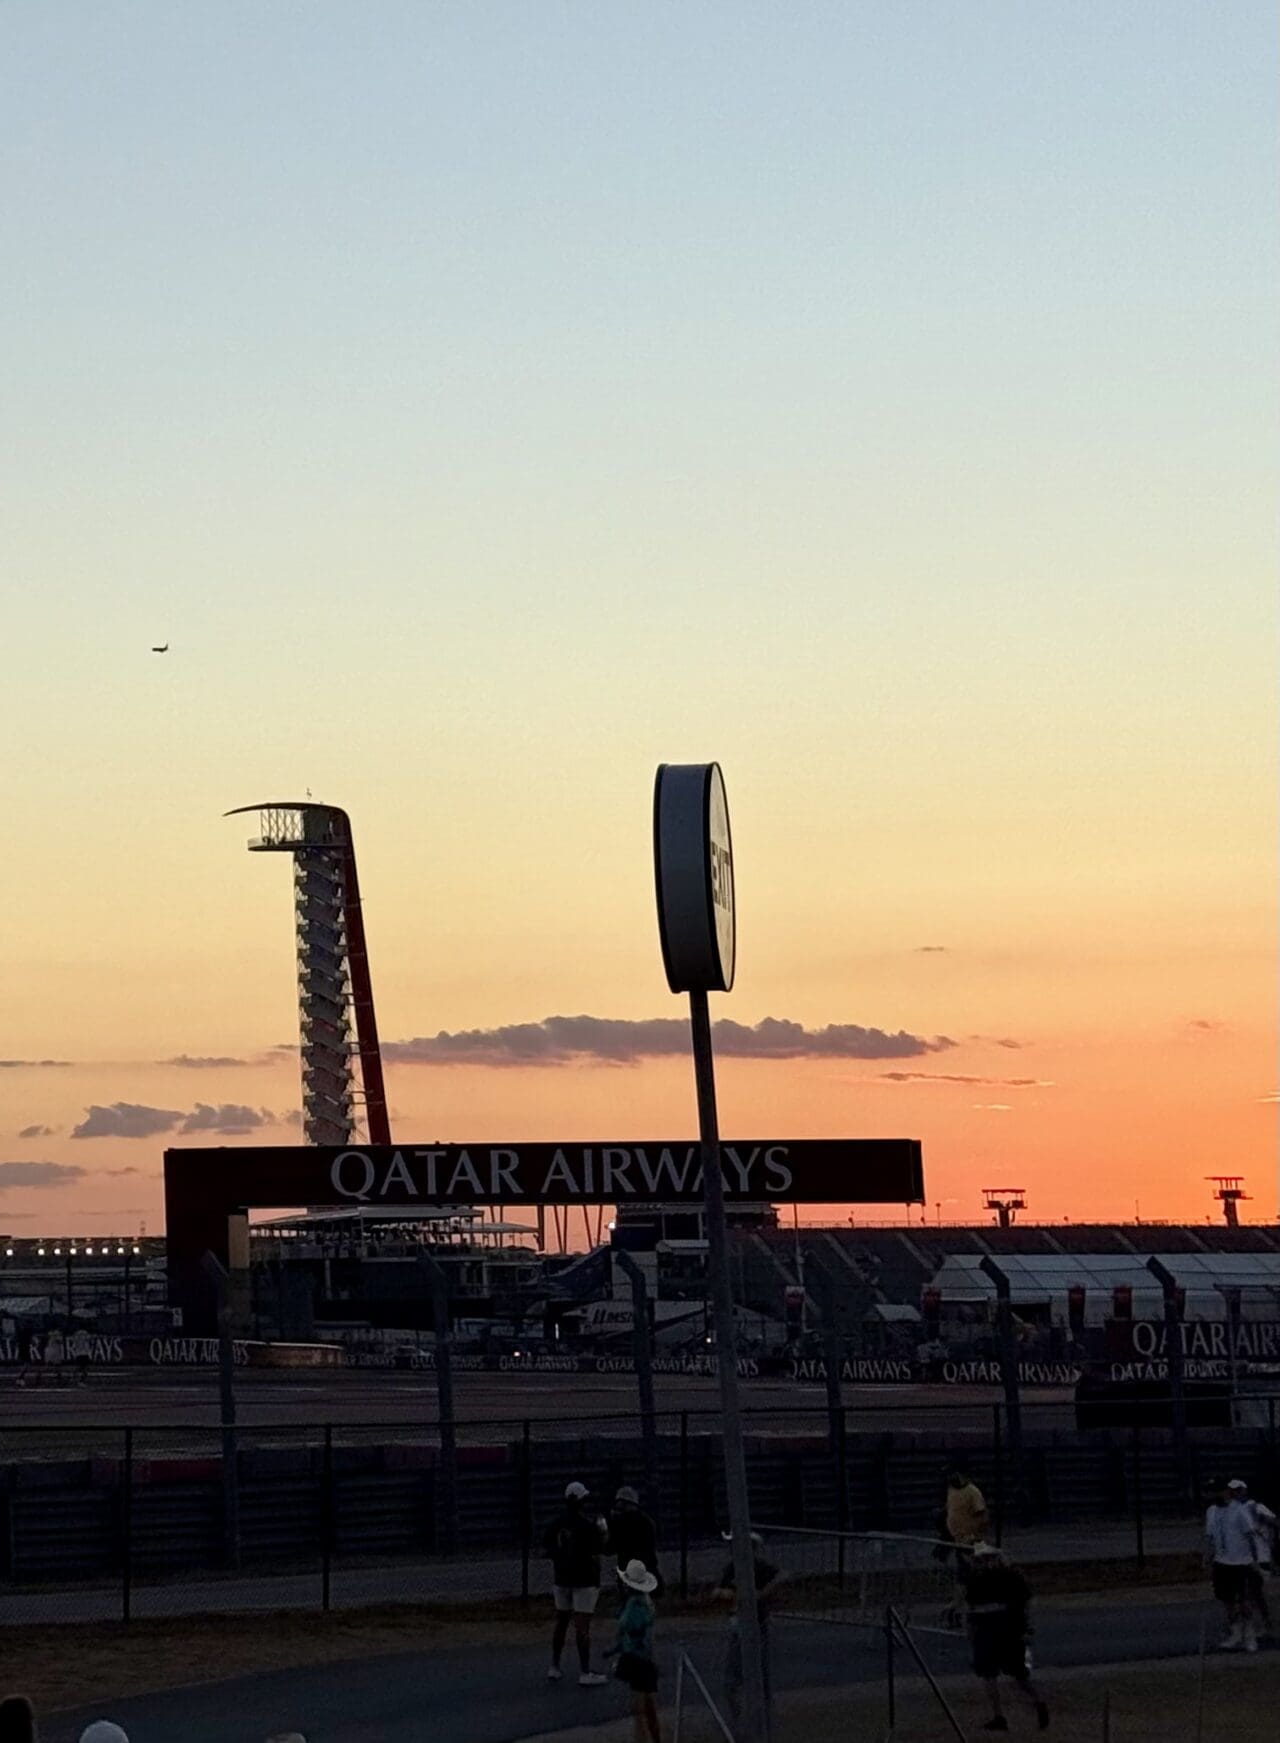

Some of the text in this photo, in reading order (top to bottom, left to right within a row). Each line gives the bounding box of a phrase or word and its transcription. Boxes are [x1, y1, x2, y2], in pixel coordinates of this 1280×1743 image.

[329, 1148, 525, 1200] QATAR
[150, 1337, 198, 1364] QATAR
[1236, 1323, 1280, 1356] AIR
[596, 1356, 635, 1372] QATAR
[789, 1360, 911, 1380] ATA AIRWAYS
[943, 1362, 1082, 1383] QATAR IRWAYS
